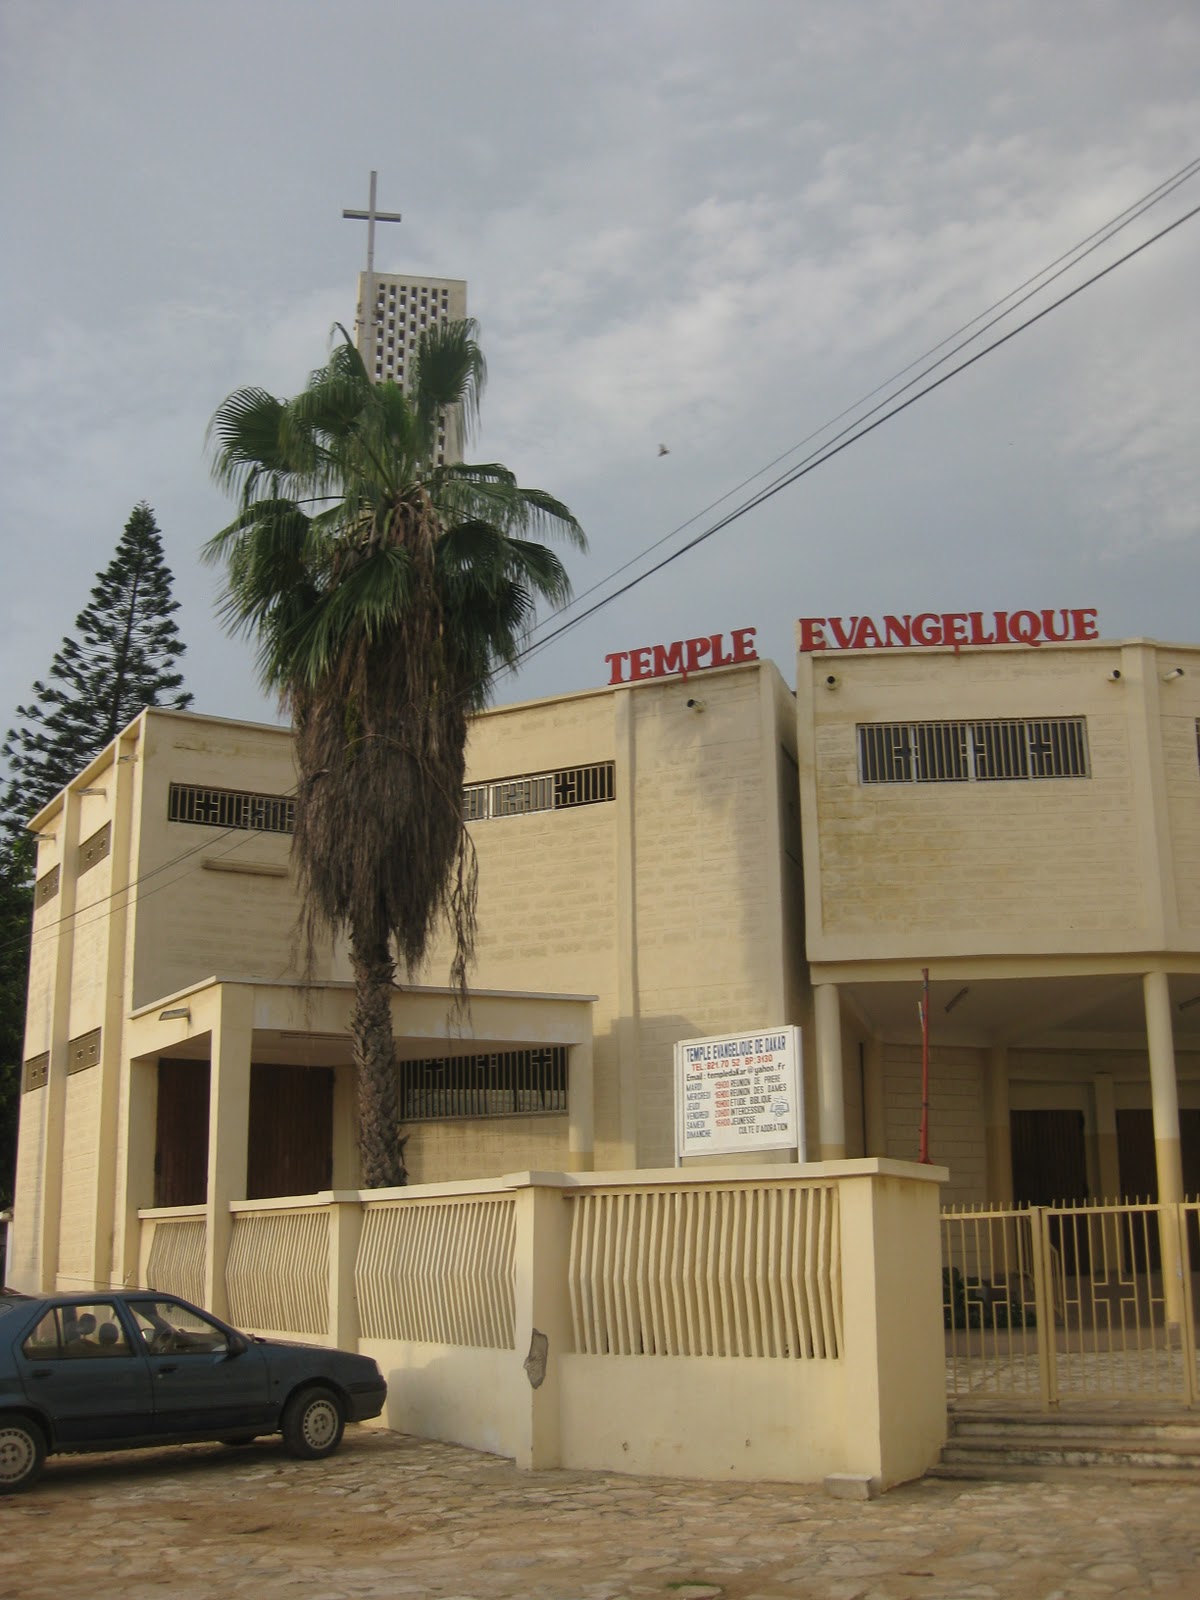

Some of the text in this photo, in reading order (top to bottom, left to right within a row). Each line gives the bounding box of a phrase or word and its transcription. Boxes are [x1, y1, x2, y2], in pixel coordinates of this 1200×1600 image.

[605, 608, 1099, 685] TEMPLE EVANGELIQUE
[687, 1036, 785, 1062] TEMPLE EVANGELIQUE DE DAKAR
[686, 1083, 702, 1091] MARDI
[687, 1092, 710, 1100] MERCREDI
[754, 1086, 764, 1094] DES
[768, 1083, 786, 1092] DAMES
[730, 1098, 746, 1106] ETUDE
[750, 1095, 772, 1105] BIBLIQUE
[731, 1106, 765, 1116] INTERCESSION
[687, 1121, 705, 1129] SAMEDI
[731, 1116, 756, 1125] JEUNESSE
[687, 1130, 711, 1139] DIMANCHE
[739, 1125, 754, 1134] CULTE
